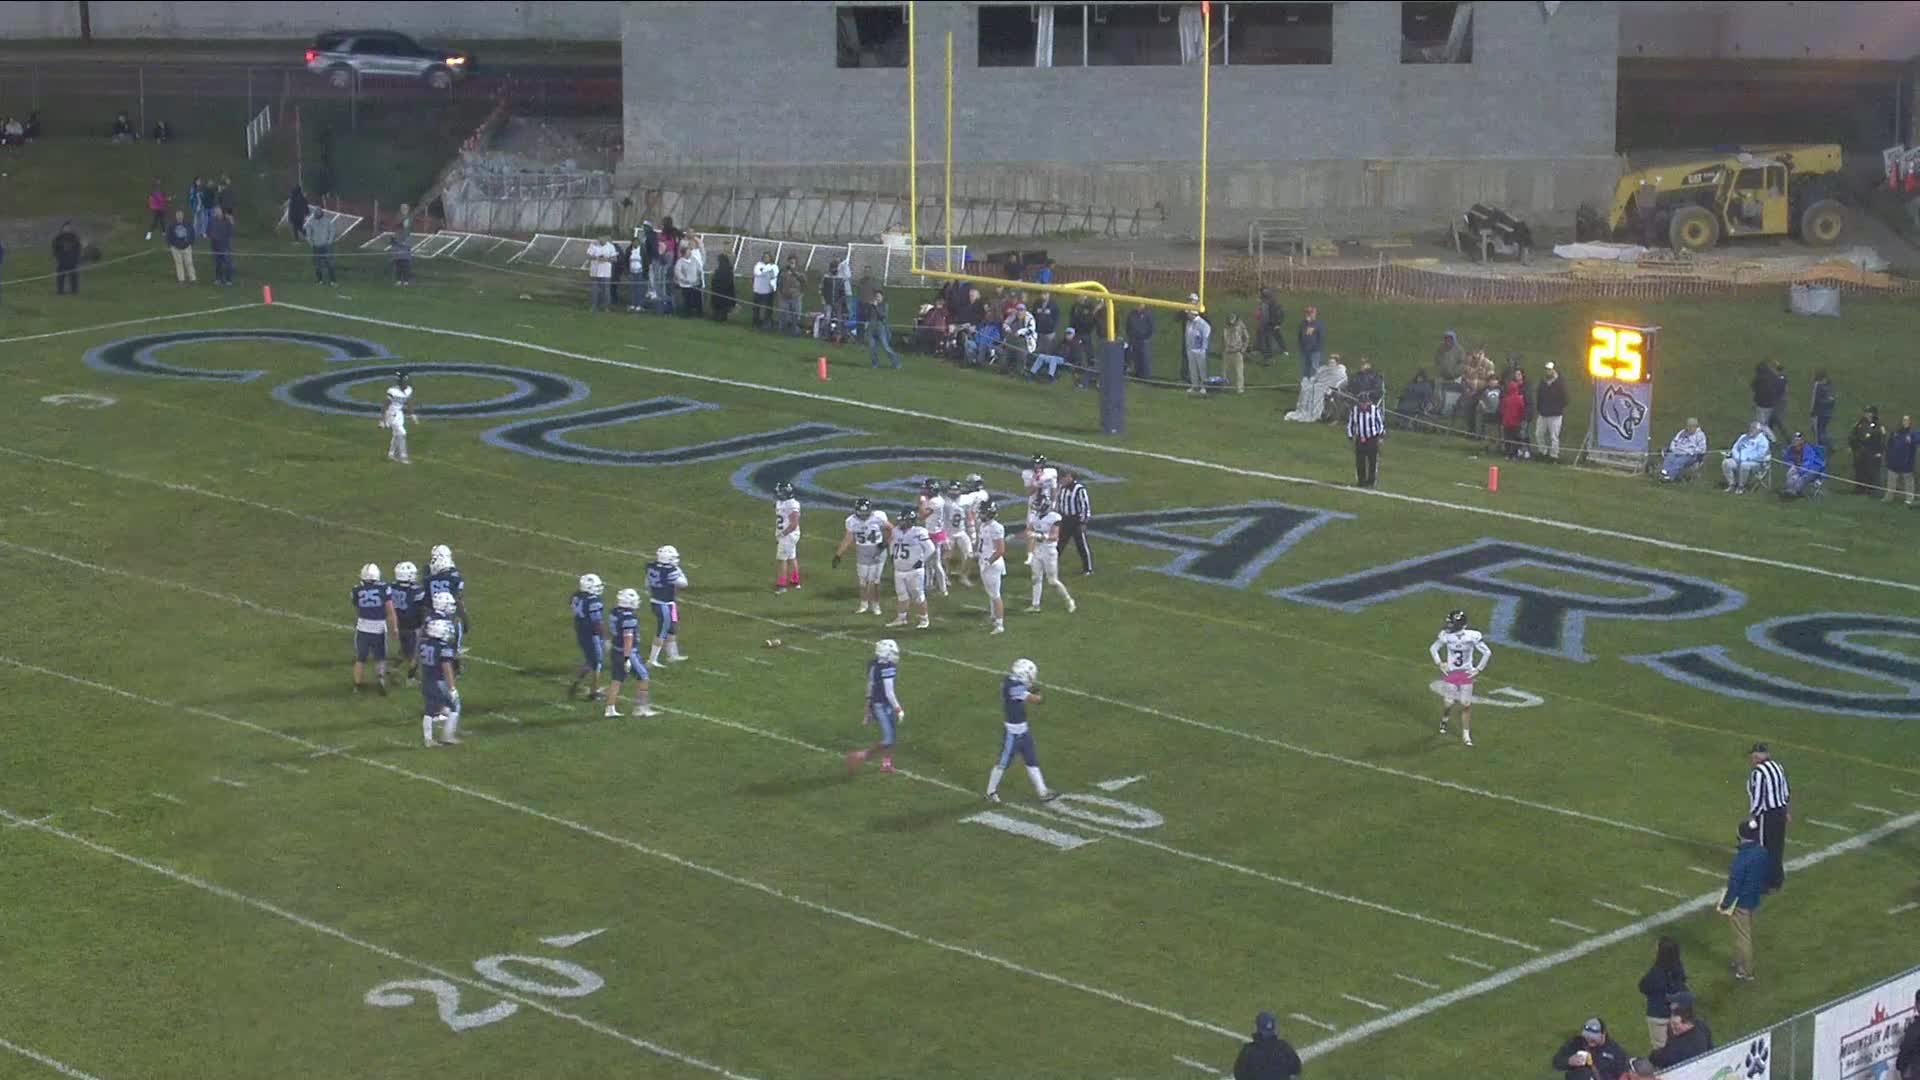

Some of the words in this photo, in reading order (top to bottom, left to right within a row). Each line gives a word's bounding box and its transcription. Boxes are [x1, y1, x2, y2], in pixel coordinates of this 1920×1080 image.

[1588, 326, 1643, 382] 25
[856, 530, 877, 544] 54
[358, 589, 382, 608] 25
[1452, 650, 1464, 668] 3
[364, 953, 605, 1032] 20
